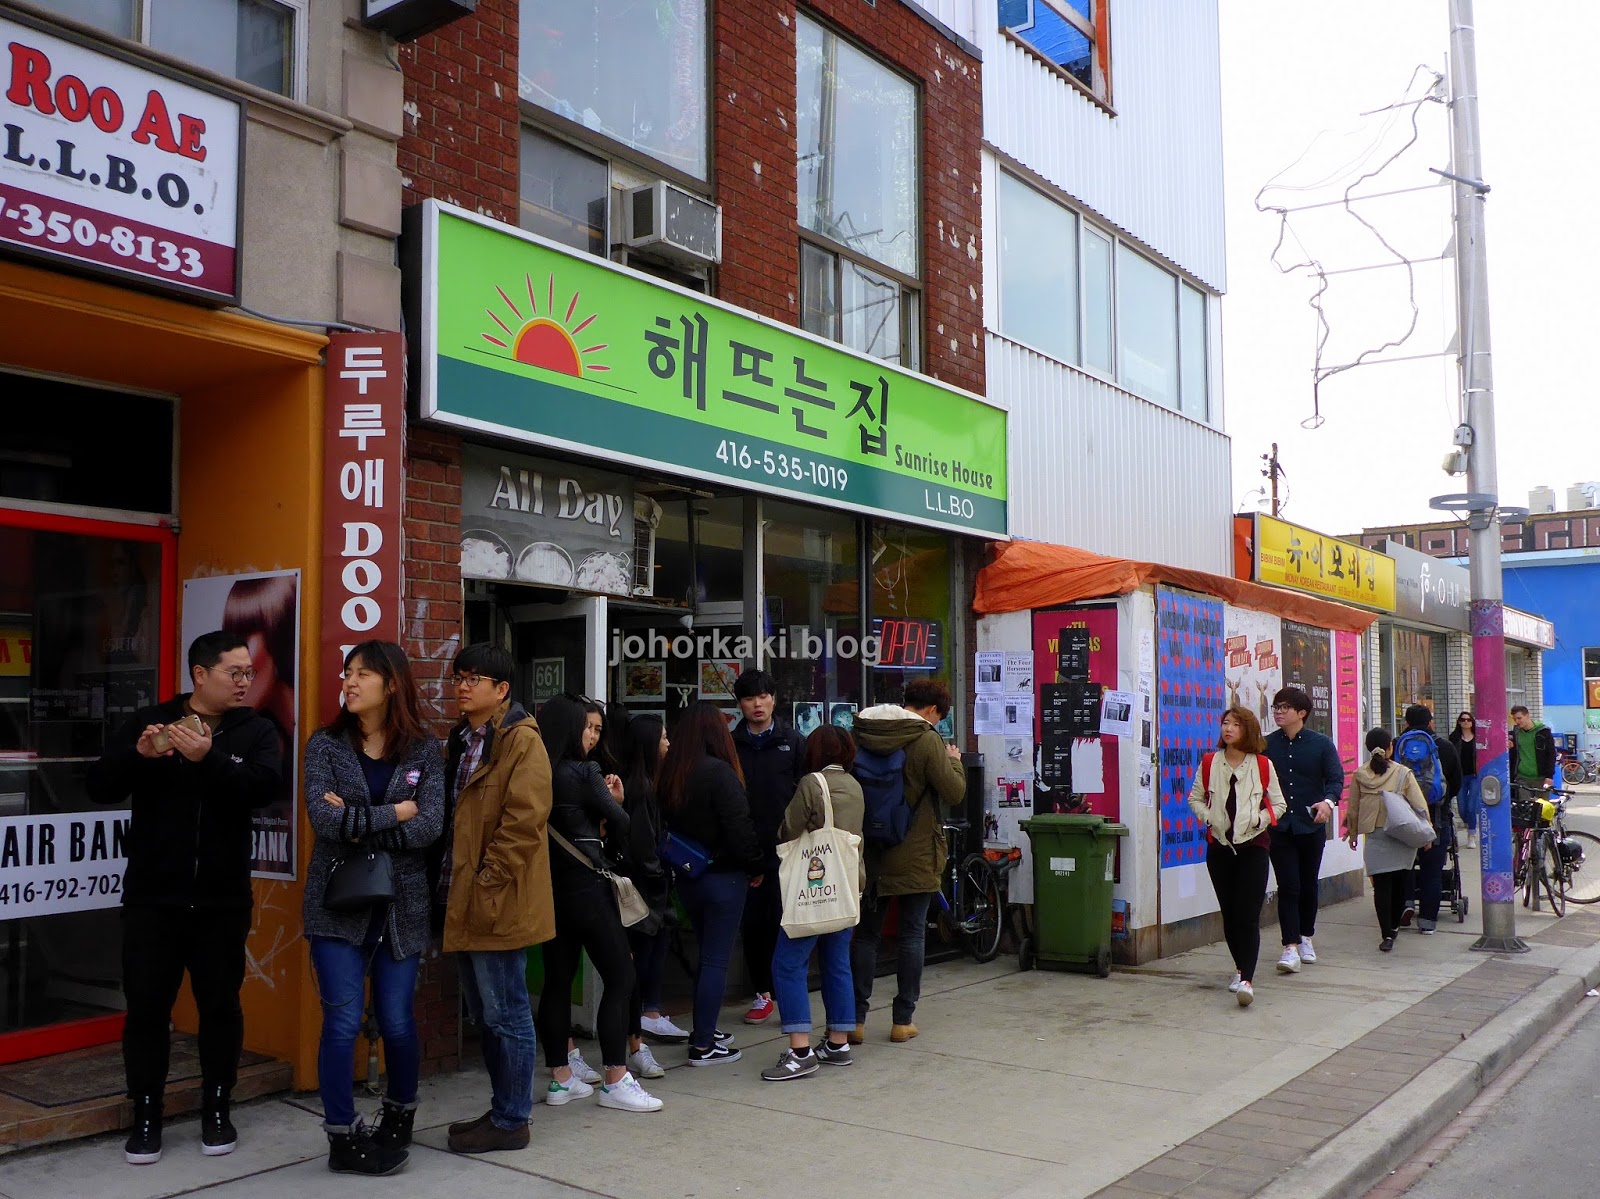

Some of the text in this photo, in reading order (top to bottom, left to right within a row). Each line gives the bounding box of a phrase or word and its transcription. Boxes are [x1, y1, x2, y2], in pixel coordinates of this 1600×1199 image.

[4, 124, 204, 215] L.L.B.O.
[0, 196, 204, 278] -350-8133
[715, 439, 848, 492] 416-535-1019
[894, 444, 993, 490] Sunrise House
[490, 466, 623, 537] All Day
[1162, 610, 1189, 631] AMERICAN
[1194, 617, 1220, 636] AMERICAN
[881, 620, 930, 665] OPEN
[536, 664, 560, 687] 661
[1164, 748, 1192, 766] AMERICAN
[1171, 778, 1185, 795] WAR
[0, 874, 125, 905] 416-792-702
[798, 884, 836, 900] AIUTO!
